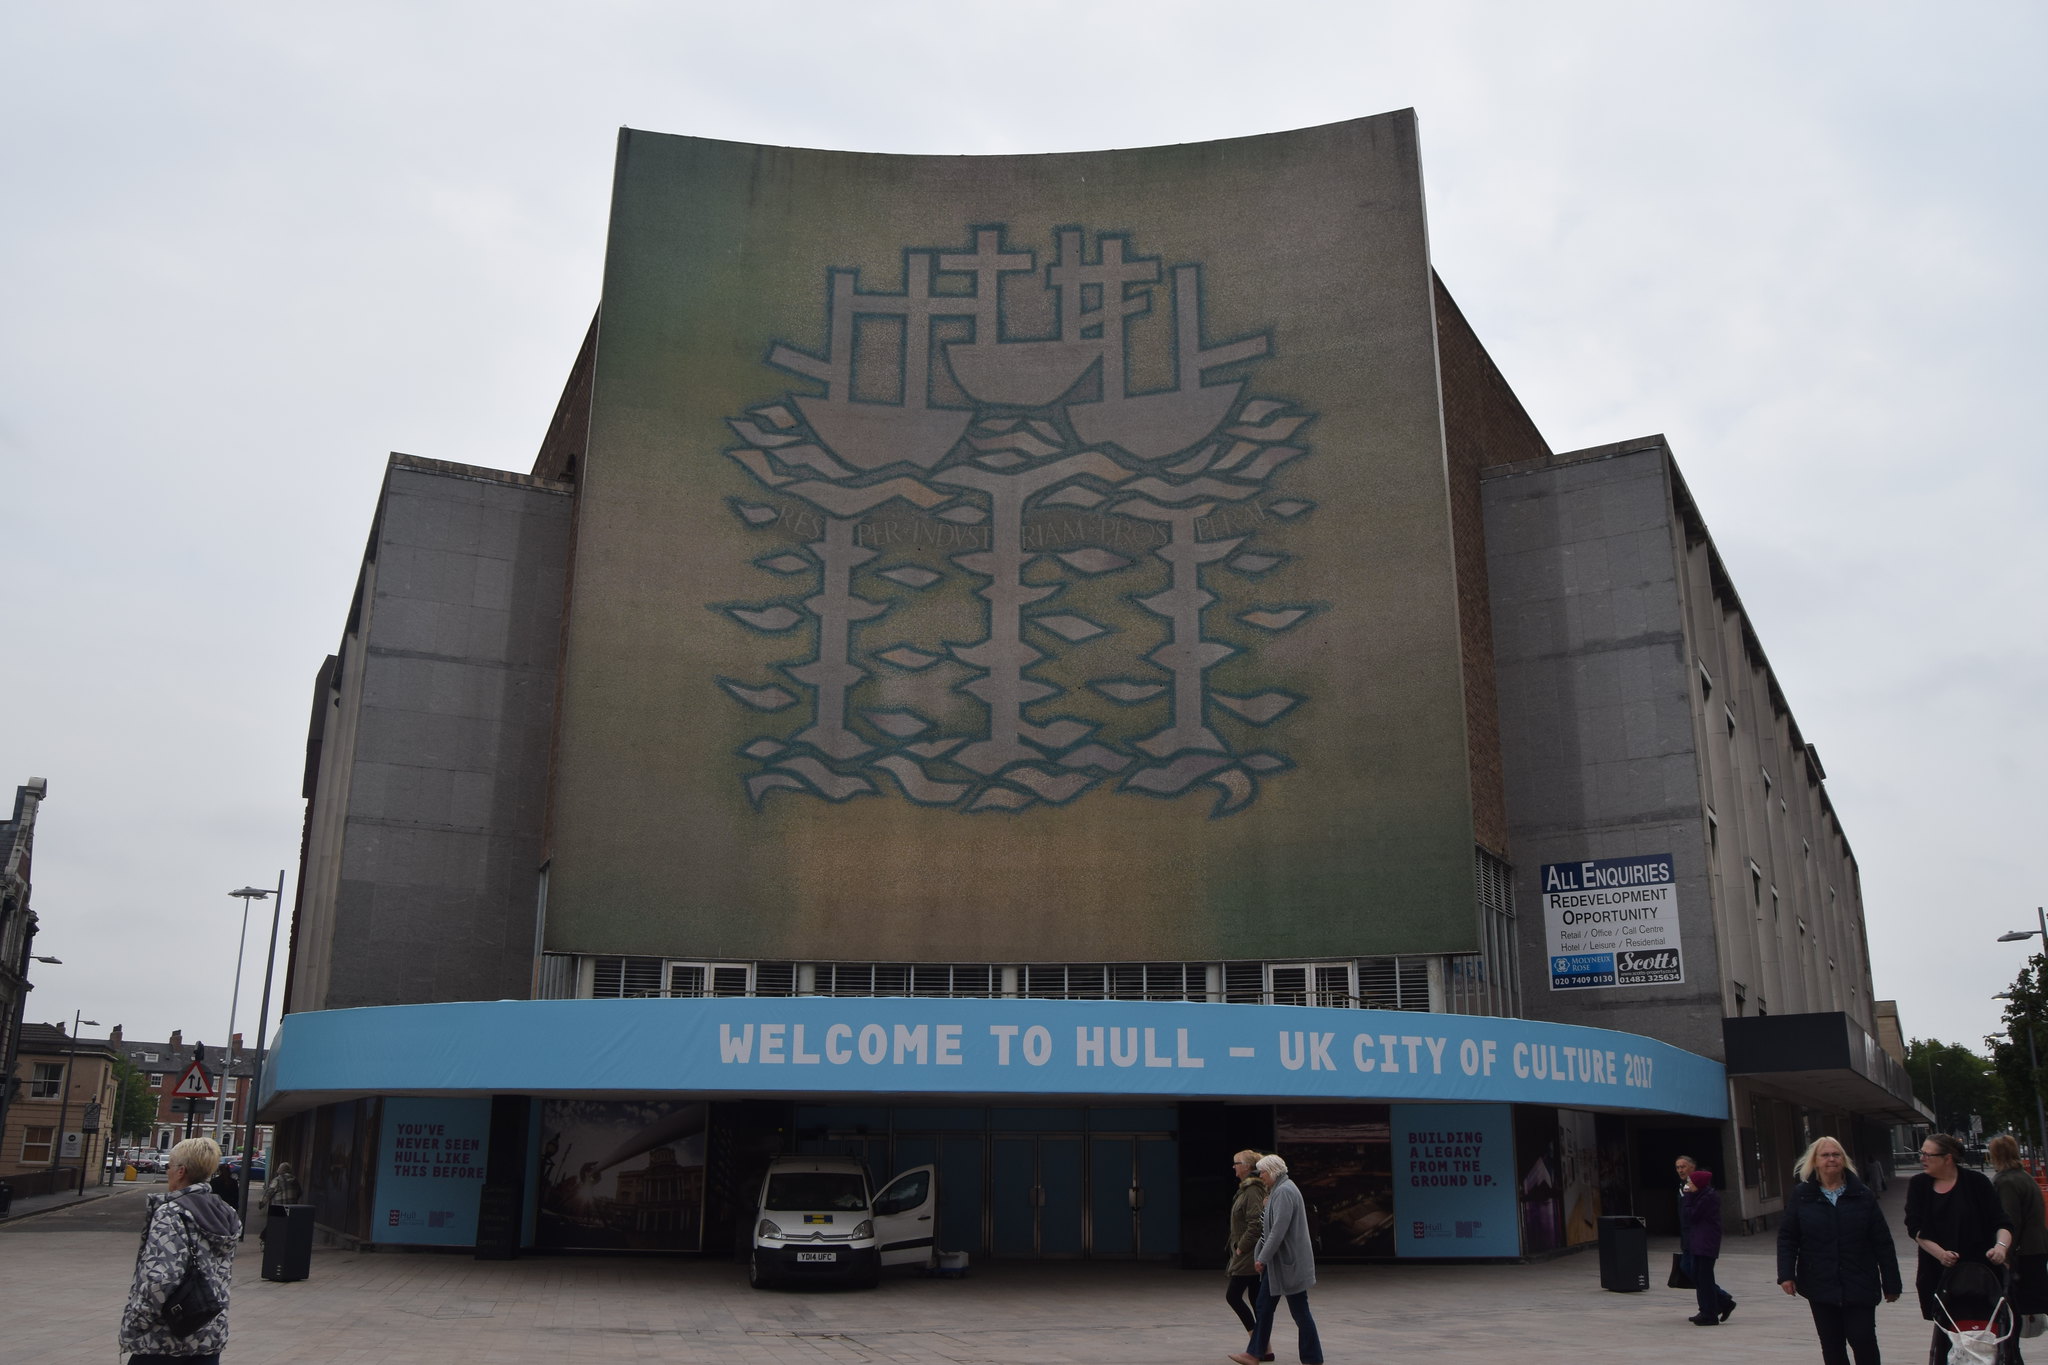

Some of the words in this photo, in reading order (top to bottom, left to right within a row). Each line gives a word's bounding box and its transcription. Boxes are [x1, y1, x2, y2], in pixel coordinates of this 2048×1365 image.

[1547, 866, 1578, 891] ALL
[1582, 862, 1670, 888] ENQUIRIES
[1550, 888, 1668, 909] REDEVELOPMENT
[1562, 907, 1658, 925] OPPORTUNITY
[1560, 930, 1581, 939] Retail
[1591, 928, 1612, 937] Office
[1622, 926, 1637, 935] Call
[1639, 925, 1664, 934] Centre
[1561, 943, 1580, 952] Hotel
[1589, 941, 1616, 950] Leisure
[1625, 937, 1666, 947] Residential
[1571, 956, 1611, 964] MOLYNEUX
[1618, 952, 1678, 971] Scotts
[1555, 977, 1569, 985] 020
[1572, 976, 1591, 984] 7409
[1593, 975, 1613, 983] 0130
[1620, 975, 1646, 984] 01482
[1648, 973, 1680, 982] 325634
[719, 1023, 963, 1066] WELCOME
[990, 1025, 1052, 1067] TO
[1076, 1026, 1205, 1068] HULL
[1279, 1031, 1337, 1072] UK
[1353, 1033, 1447, 1075] CITY
[1460, 1038, 1497, 1077] OF
[1513, 1042, 1617, 1084] CULTURE
[1625, 1053, 1654, 1089] 2017
[397, 1123, 445, 1136] YOU'VE
[396, 1137, 440, 1150] NEVER
[445, 1138, 480, 1151] SEEN
[1408, 1132, 1483, 1144] BUILDING
[395, 1151, 430, 1163] HULL
[436, 1152, 471, 1164] LIKE
[1410, 1146, 1419, 1158] A
[1425, 1146, 1481, 1158] LEGACY
[394, 1165, 427, 1177] THIS
[1410, 1160, 1448, 1172] FROM
[1453, 1160, 1480, 1172] THE
[1411, 1175, 1467, 1187] GROUND
[1473, 1175, 1497, 1186] UP.
